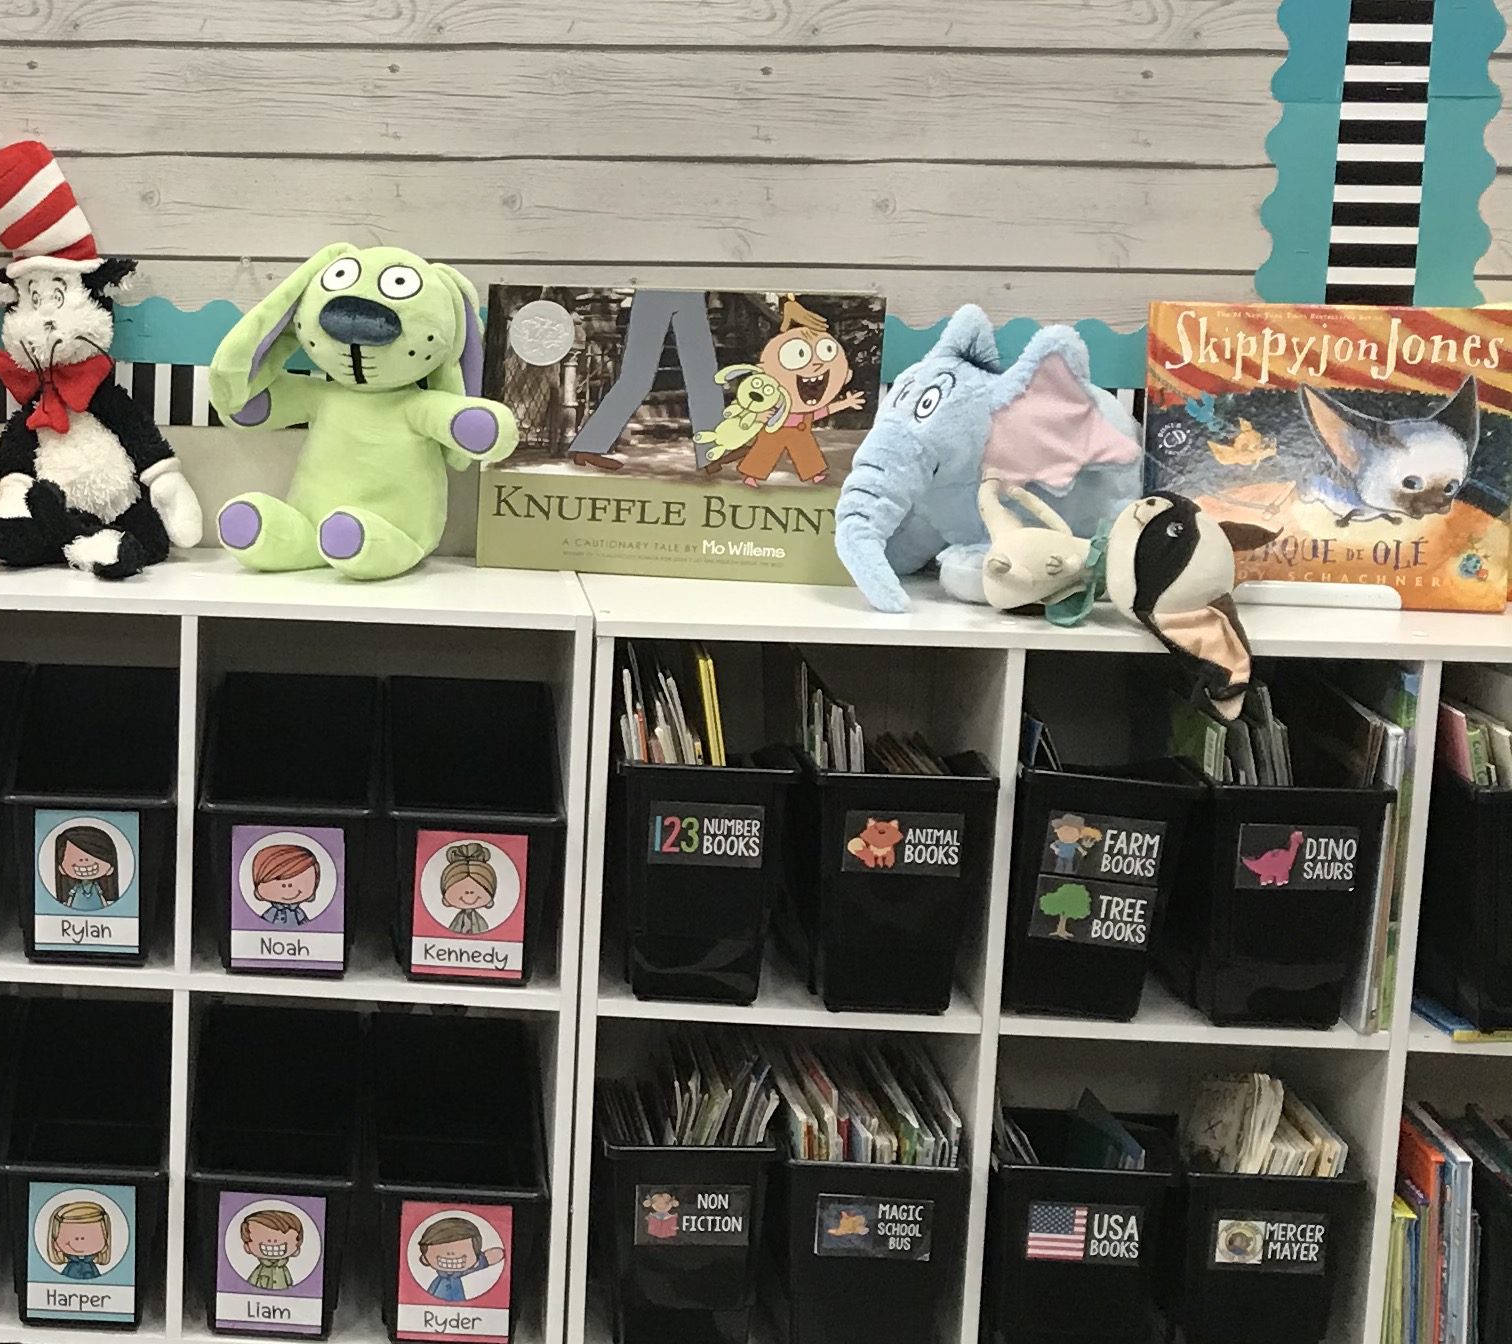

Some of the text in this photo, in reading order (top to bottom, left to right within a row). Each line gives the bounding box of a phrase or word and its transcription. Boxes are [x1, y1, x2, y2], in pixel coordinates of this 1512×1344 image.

[493, 485, 686, 527] KNUFFLE
[562, 538, 786, 558] A CAUTIONARY TALE BY Mo Willems
[1288, 571, 1441, 588] SCHACHNER
[653, 815, 699, 853] 123
[703, 817, 761, 836] NUMBER
[905, 827, 960, 846] ANIMAL
[702, 836, 760, 857] BOOKS
[1105, 829, 1161, 858] FARM
[1304, 837, 1357, 860] DINO
[903, 844, 959, 865] BOOKS
[1100, 854, 1156, 878] BOOKS
[1303, 861, 1354, 880] SAURS
[1099, 894, 1147, 923] TREE
[61, 918, 113, 941] Rylan
[1091, 919, 1147, 945] BOOKS
[260, 937, 310, 958] Noah
[424, 943, 510, 969] Kennedy
[697, 1193, 729, 1210] NON
[878, 1203, 924, 1221] MAGIC
[682, 1216, 742, 1232] FICTION
[877, 1222, 922, 1238] SCHOOL
[1093, 1213, 1139, 1241] USA
[1265, 1222, 1325, 1243] MERCER
[888, 1236, 911, 1251] BUS
[1090, 1240, 1139, 1259] BOOKS
[1268, 1242, 1319, 1262] MAYER
[47, 1290, 111, 1312] Harper
[247, 1302, 291, 1321] Liam
[424, 1312, 482, 1334] Ryder
